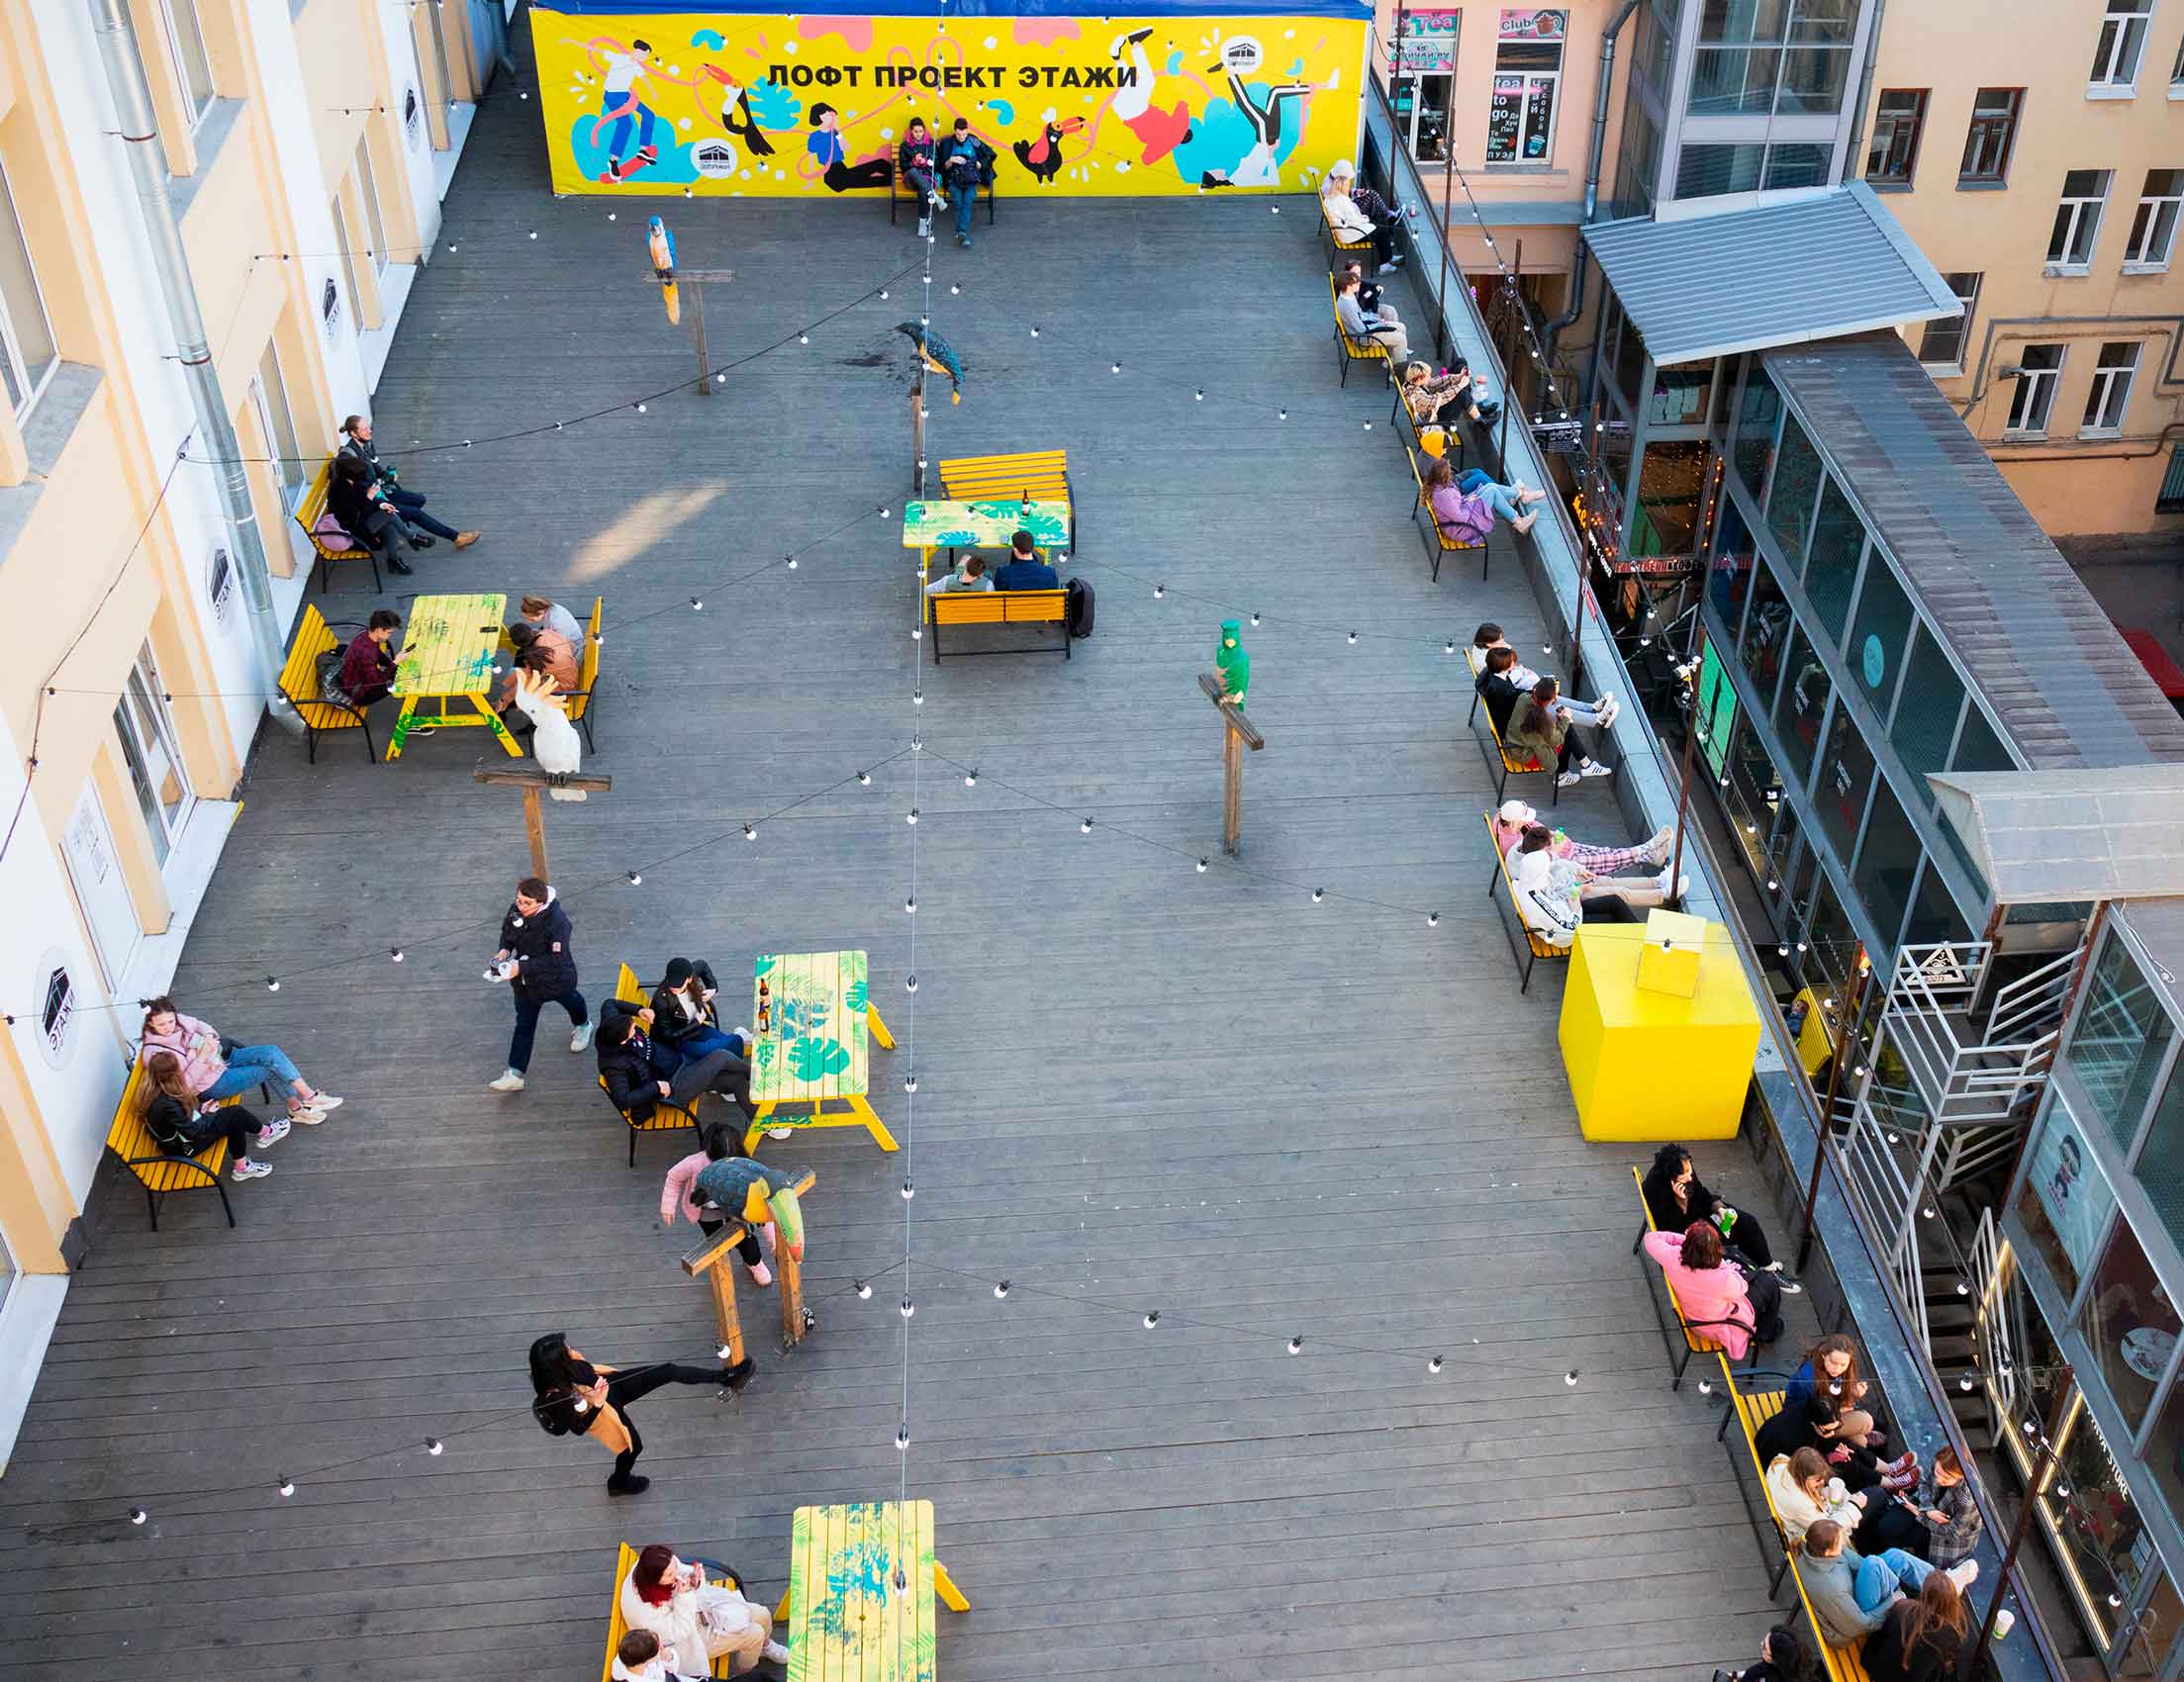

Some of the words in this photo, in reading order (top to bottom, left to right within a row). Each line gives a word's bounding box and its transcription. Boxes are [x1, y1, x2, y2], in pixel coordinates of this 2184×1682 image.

[1411, 15, 1457, 37] Tea
[1501, 18, 1532, 31] Club
[767, 64, 861, 88] ЛОФТ
[875, 64, 1005, 88] ПРОЕКТ
[1018, 64, 1136, 88] ЭТАЖИ
[1494, 77, 1521, 89] tea
[1493, 95, 1508, 106] to
[1491, 109, 1509, 122] go
[47, 986, 76, 1051] ЭТАЖИ
